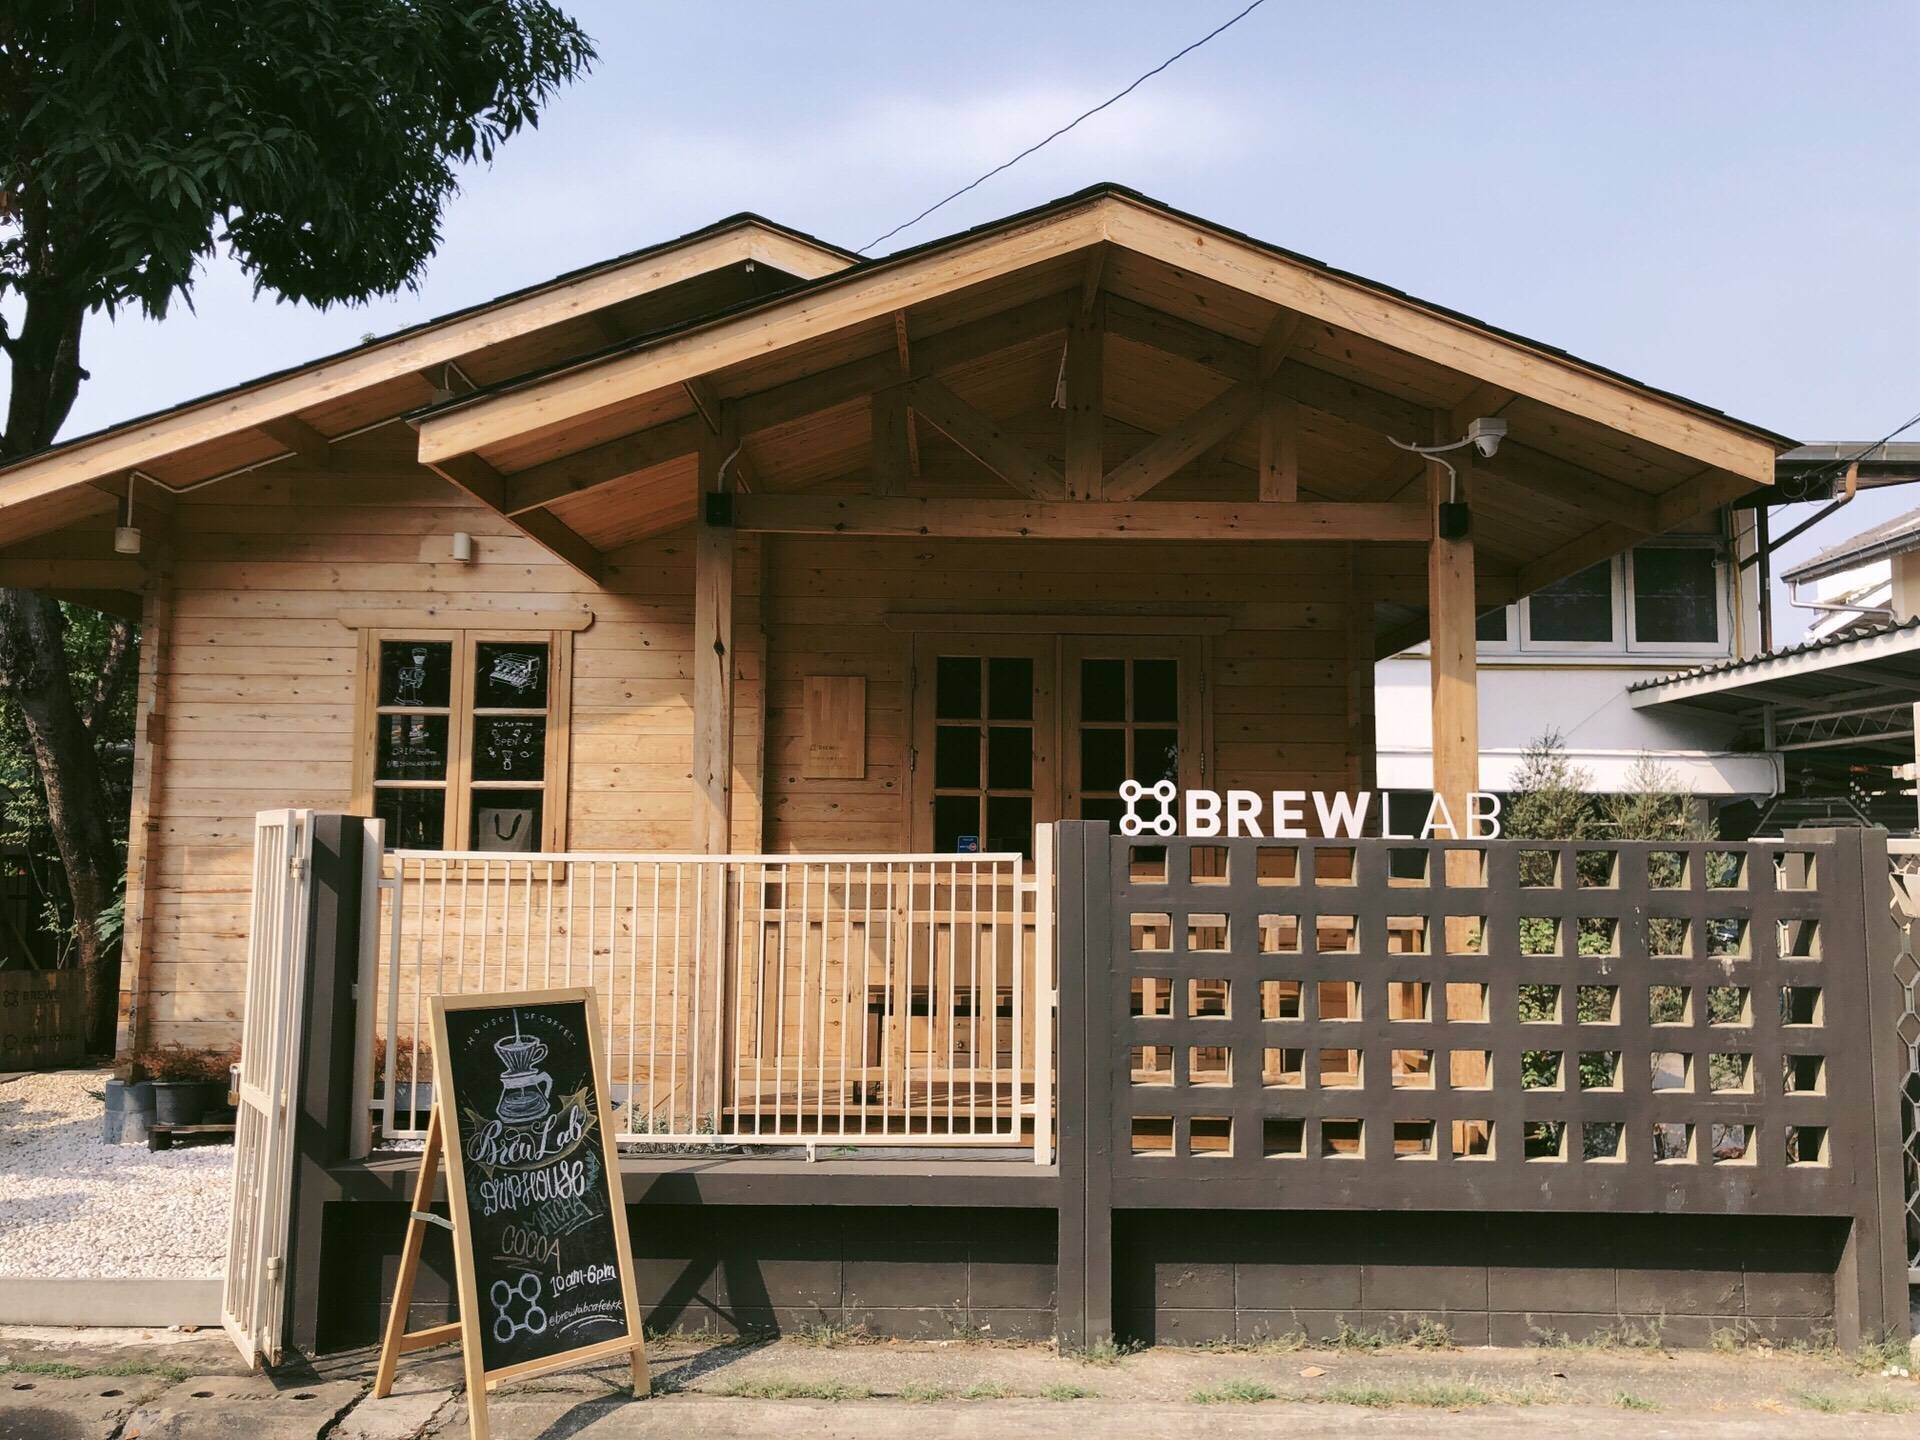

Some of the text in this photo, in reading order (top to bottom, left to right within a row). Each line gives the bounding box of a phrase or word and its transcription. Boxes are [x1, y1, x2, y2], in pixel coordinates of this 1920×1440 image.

[1185, 790, 1501, 840] BREWLAB
[467, 1105, 586, 1165] Brew Lab
[502, 1224, 561, 1274] COCOA
